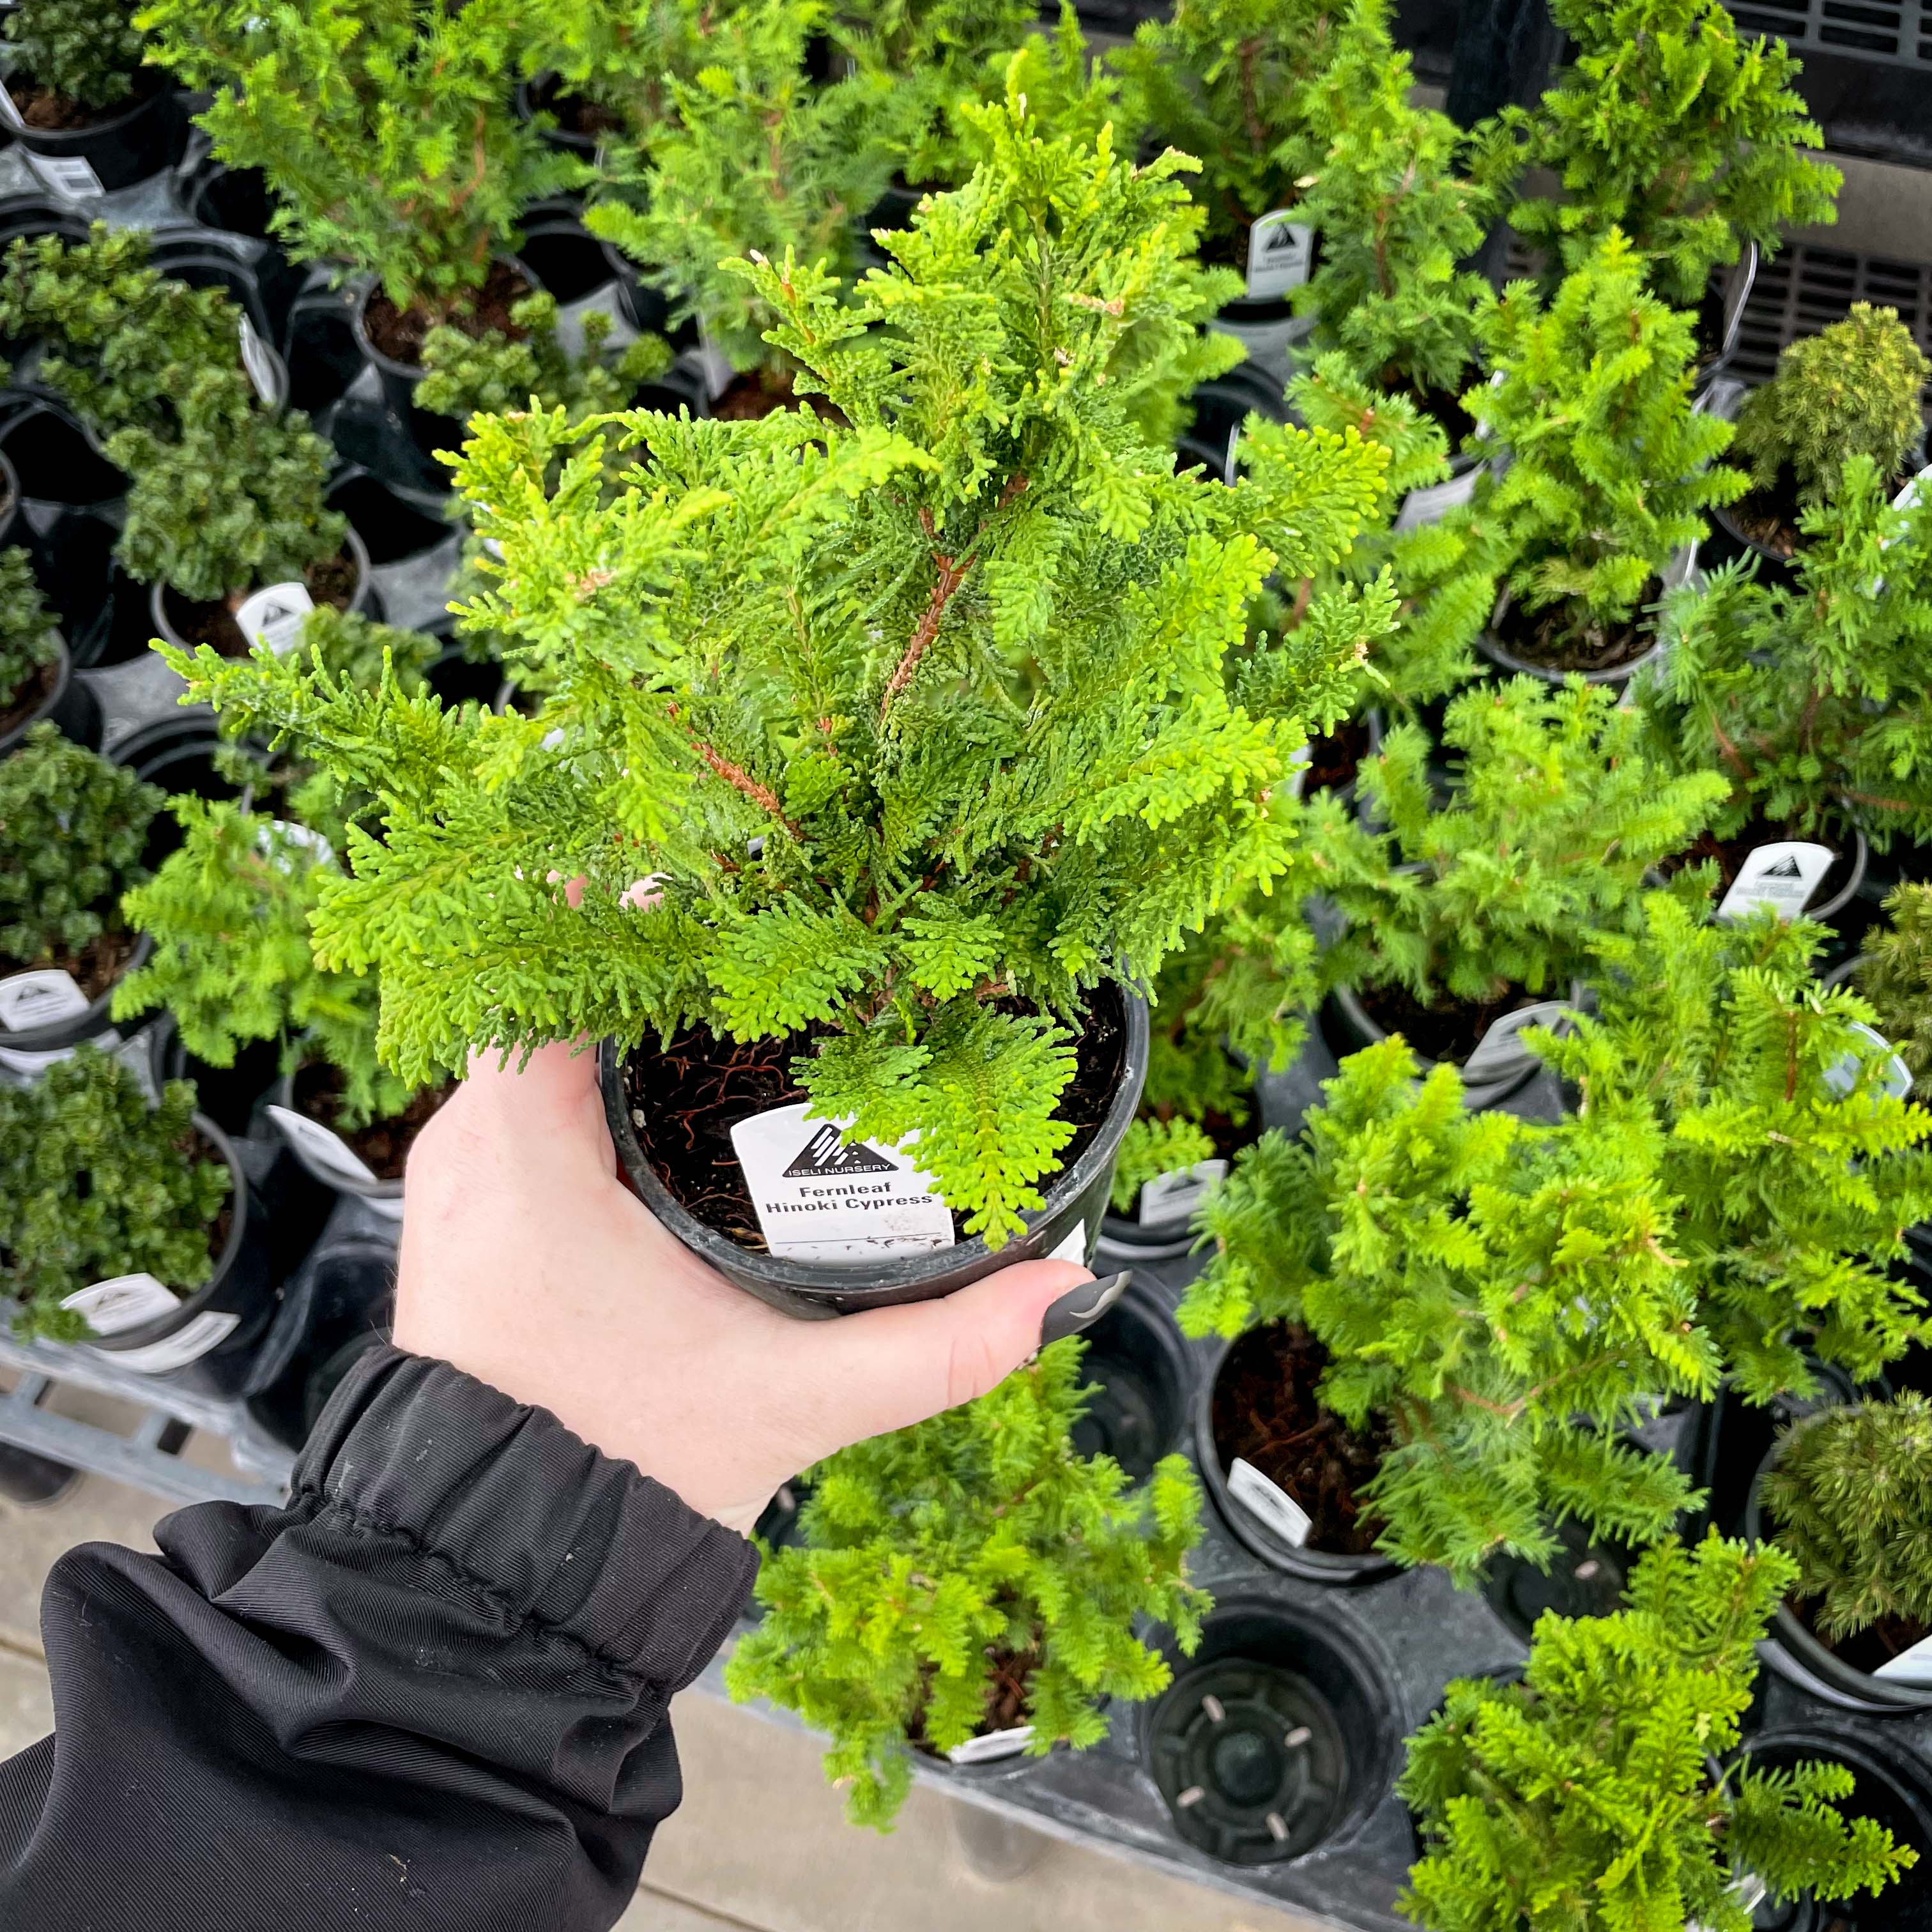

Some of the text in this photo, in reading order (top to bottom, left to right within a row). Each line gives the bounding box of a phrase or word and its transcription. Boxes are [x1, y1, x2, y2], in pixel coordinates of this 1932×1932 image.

[825, 1164, 890, 1174] NURSERY
[799, 1182, 891, 1197] Fernleaf
[765, 1195, 933, 1213] Hinoki Cypress
